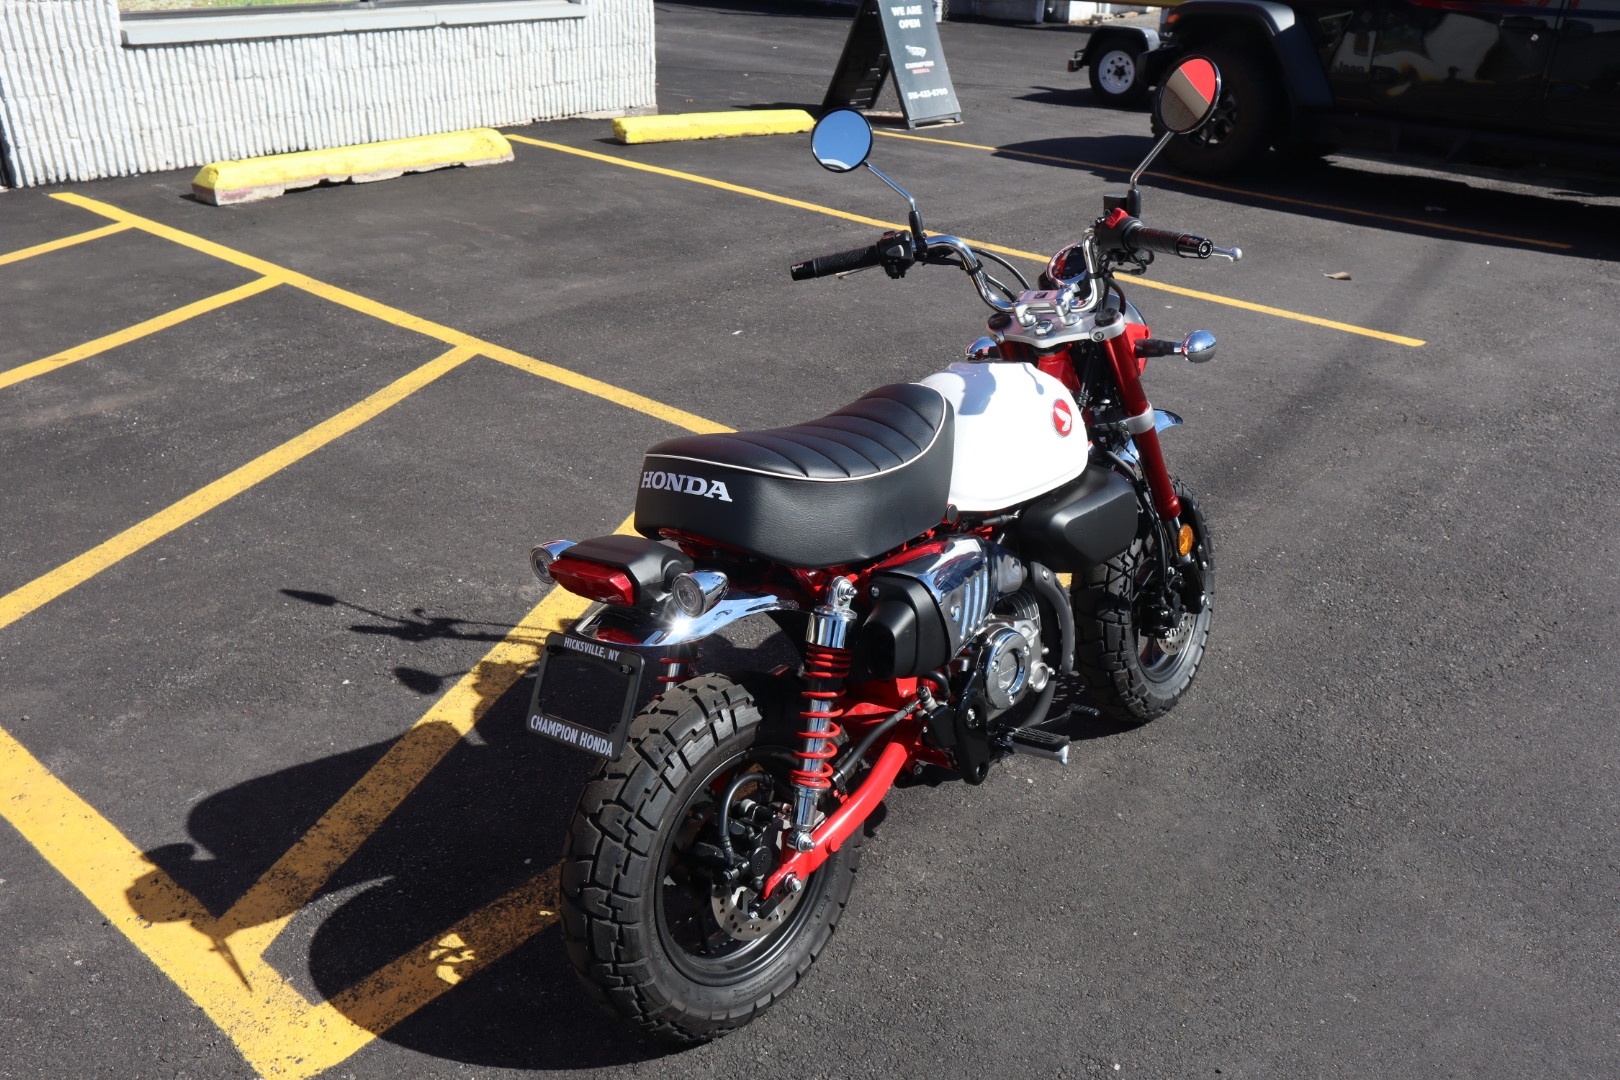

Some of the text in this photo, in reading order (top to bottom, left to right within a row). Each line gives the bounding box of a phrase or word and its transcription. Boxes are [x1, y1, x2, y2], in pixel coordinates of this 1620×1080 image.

[891, 5, 923, 16] WE ARE
[899, 19, 920, 29] OPEN
[640, 471, 733, 503] HONDA
[563, 637, 621, 662] HICKSVILLE, NY
[530, 714, 614, 757] CHAMPION HONDA
